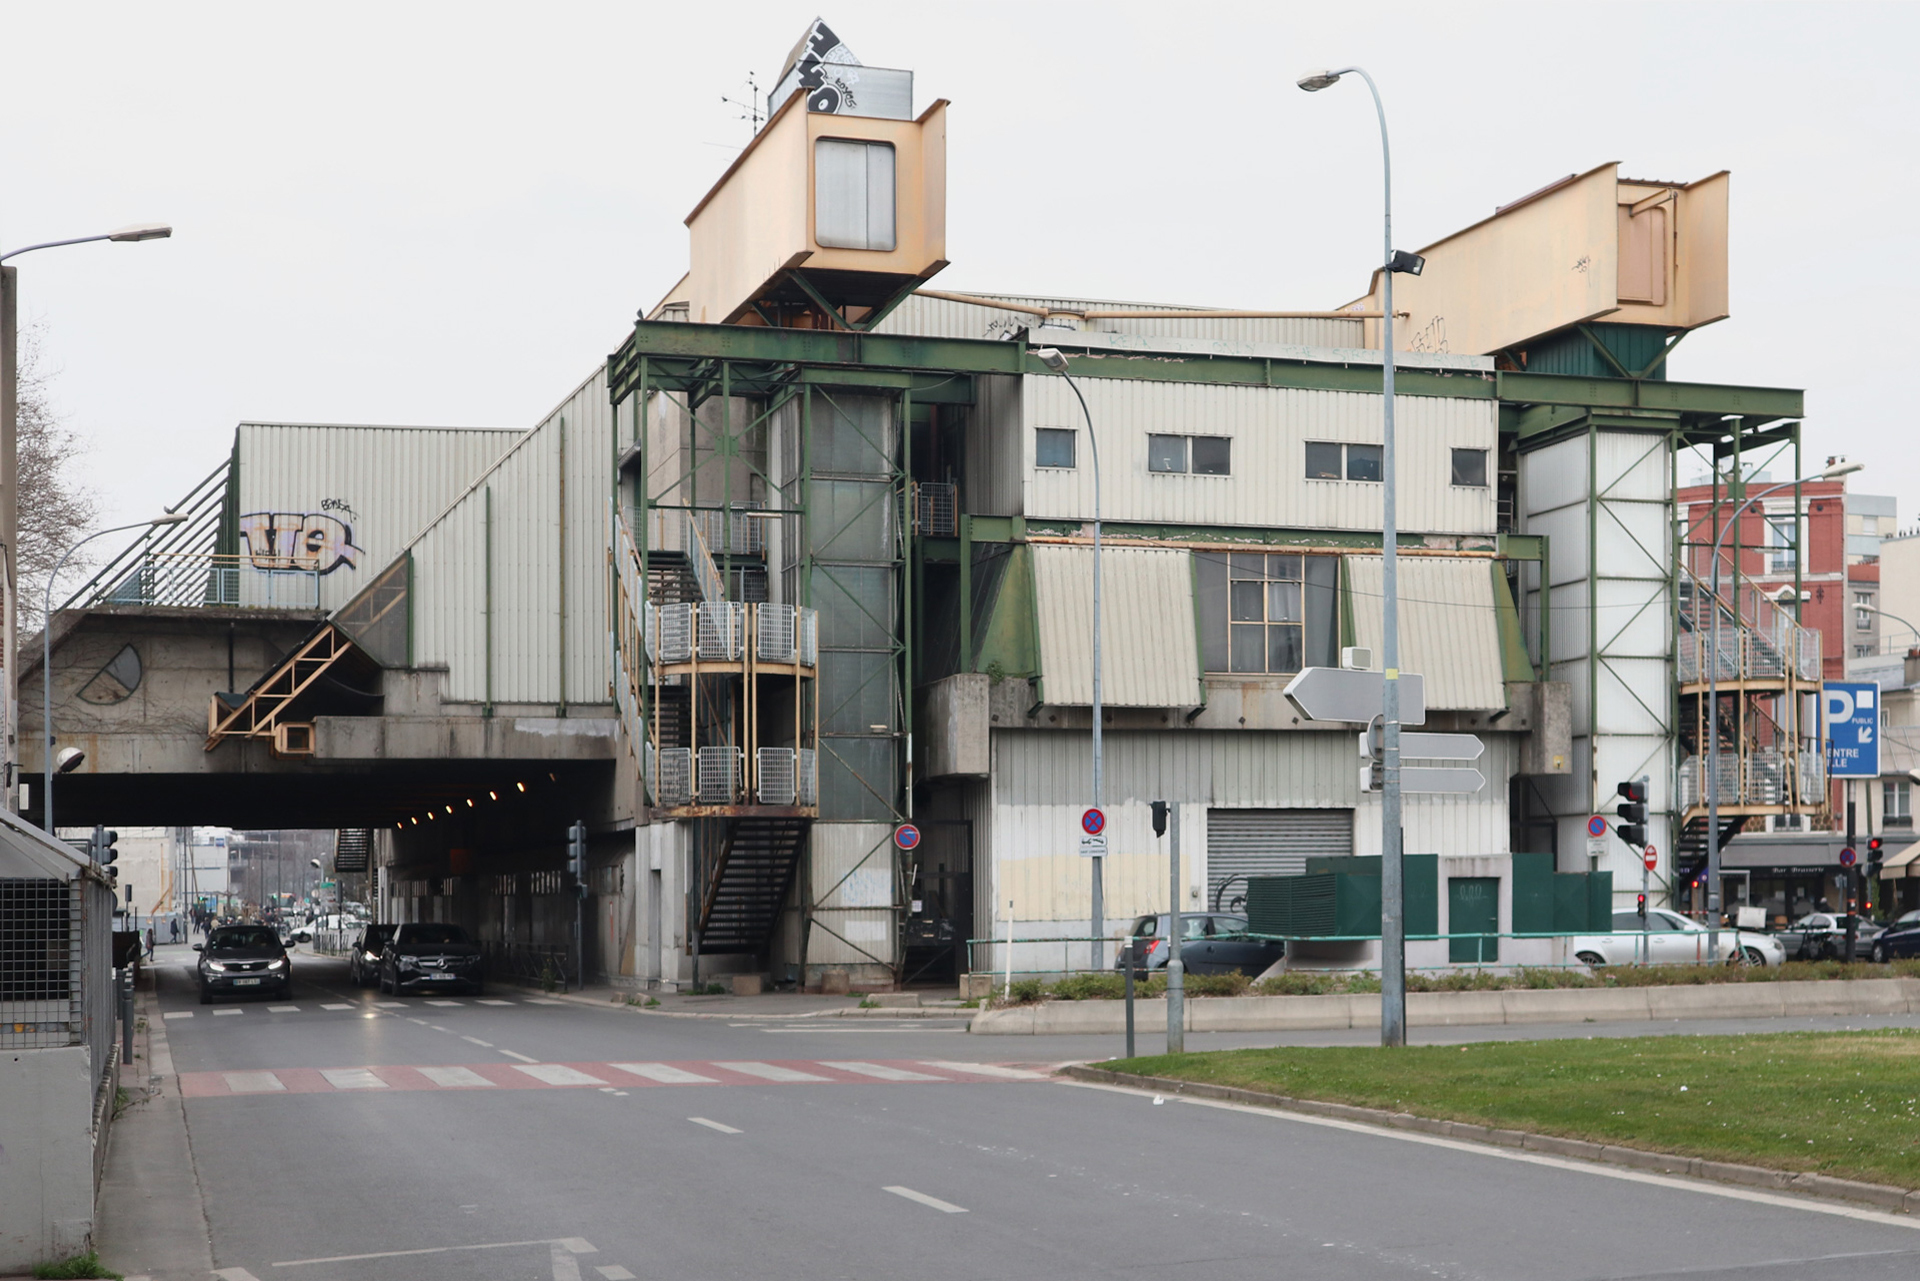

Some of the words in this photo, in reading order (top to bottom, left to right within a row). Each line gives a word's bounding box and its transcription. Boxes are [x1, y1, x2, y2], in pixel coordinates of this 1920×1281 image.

[1823, 689, 1854, 739] P
[1851, 717, 1873, 725] PUBLIC
[1827, 748, 1859, 758] ENTRE
